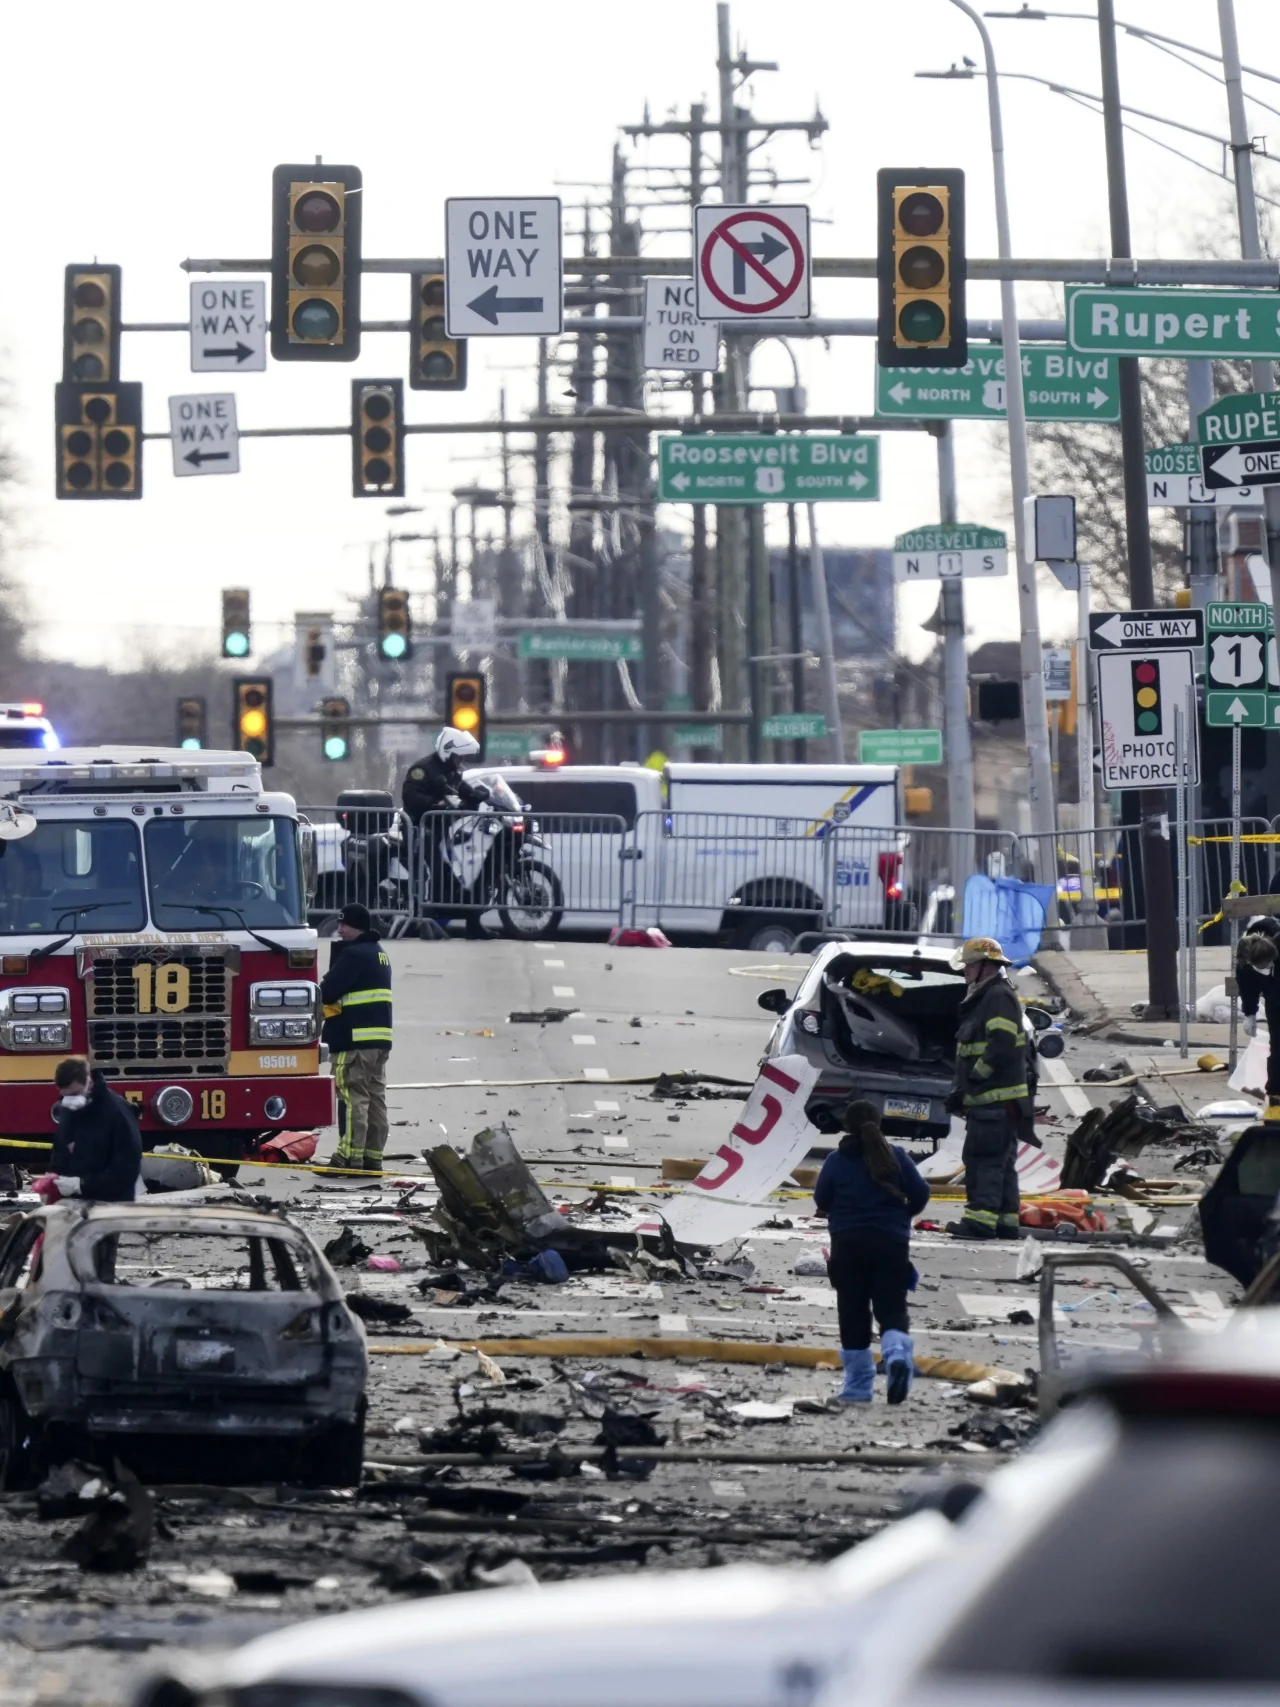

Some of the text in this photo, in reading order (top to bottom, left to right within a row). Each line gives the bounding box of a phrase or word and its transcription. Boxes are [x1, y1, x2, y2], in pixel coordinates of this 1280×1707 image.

[469, 211, 538, 240] ONE
[467, 249, 539, 278] WAY
[202, 290, 255, 310] ONE
[201, 315, 255, 334] WAY
[657, 310, 698, 325] TUR
[1091, 302, 1251, 345] Rupert
[669, 329, 694, 344] ON
[663, 348, 700, 363] RED
[1045, 355, 1108, 379] Blvd
[918, 387, 1080, 404] NORTH 1 SOUTH
[180, 401, 228, 420] ONE
[180, 423, 230, 442] WAY
[1205, 411, 1280, 440] RUPE
[670, 443, 868, 465] Roosevelt Blvd
[1145, 455, 1200, 472] ROOSE
[1245, 453, 1280, 473] ONE
[696, 475, 745, 488] NORTH
[796, 475, 843, 488] SOUTH
[1154, 481, 1167, 498] N
[896, 532, 978, 551] ROOSEVELT
[907, 559, 919, 573] N
[983, 556, 994, 570] S
[1212, 608, 1263, 624] NORTH
[1123, 621, 1191, 637] ONE WAY
[1228, 643, 1242, 677] 1
[81, 933, 163, 945] PHILADELPHIA
[166, 933, 193, 943] FIRE
[132, 963, 190, 1013] 18
[258, 1055, 298, 1069] 195014
[200, 1089, 226, 1120] 18
